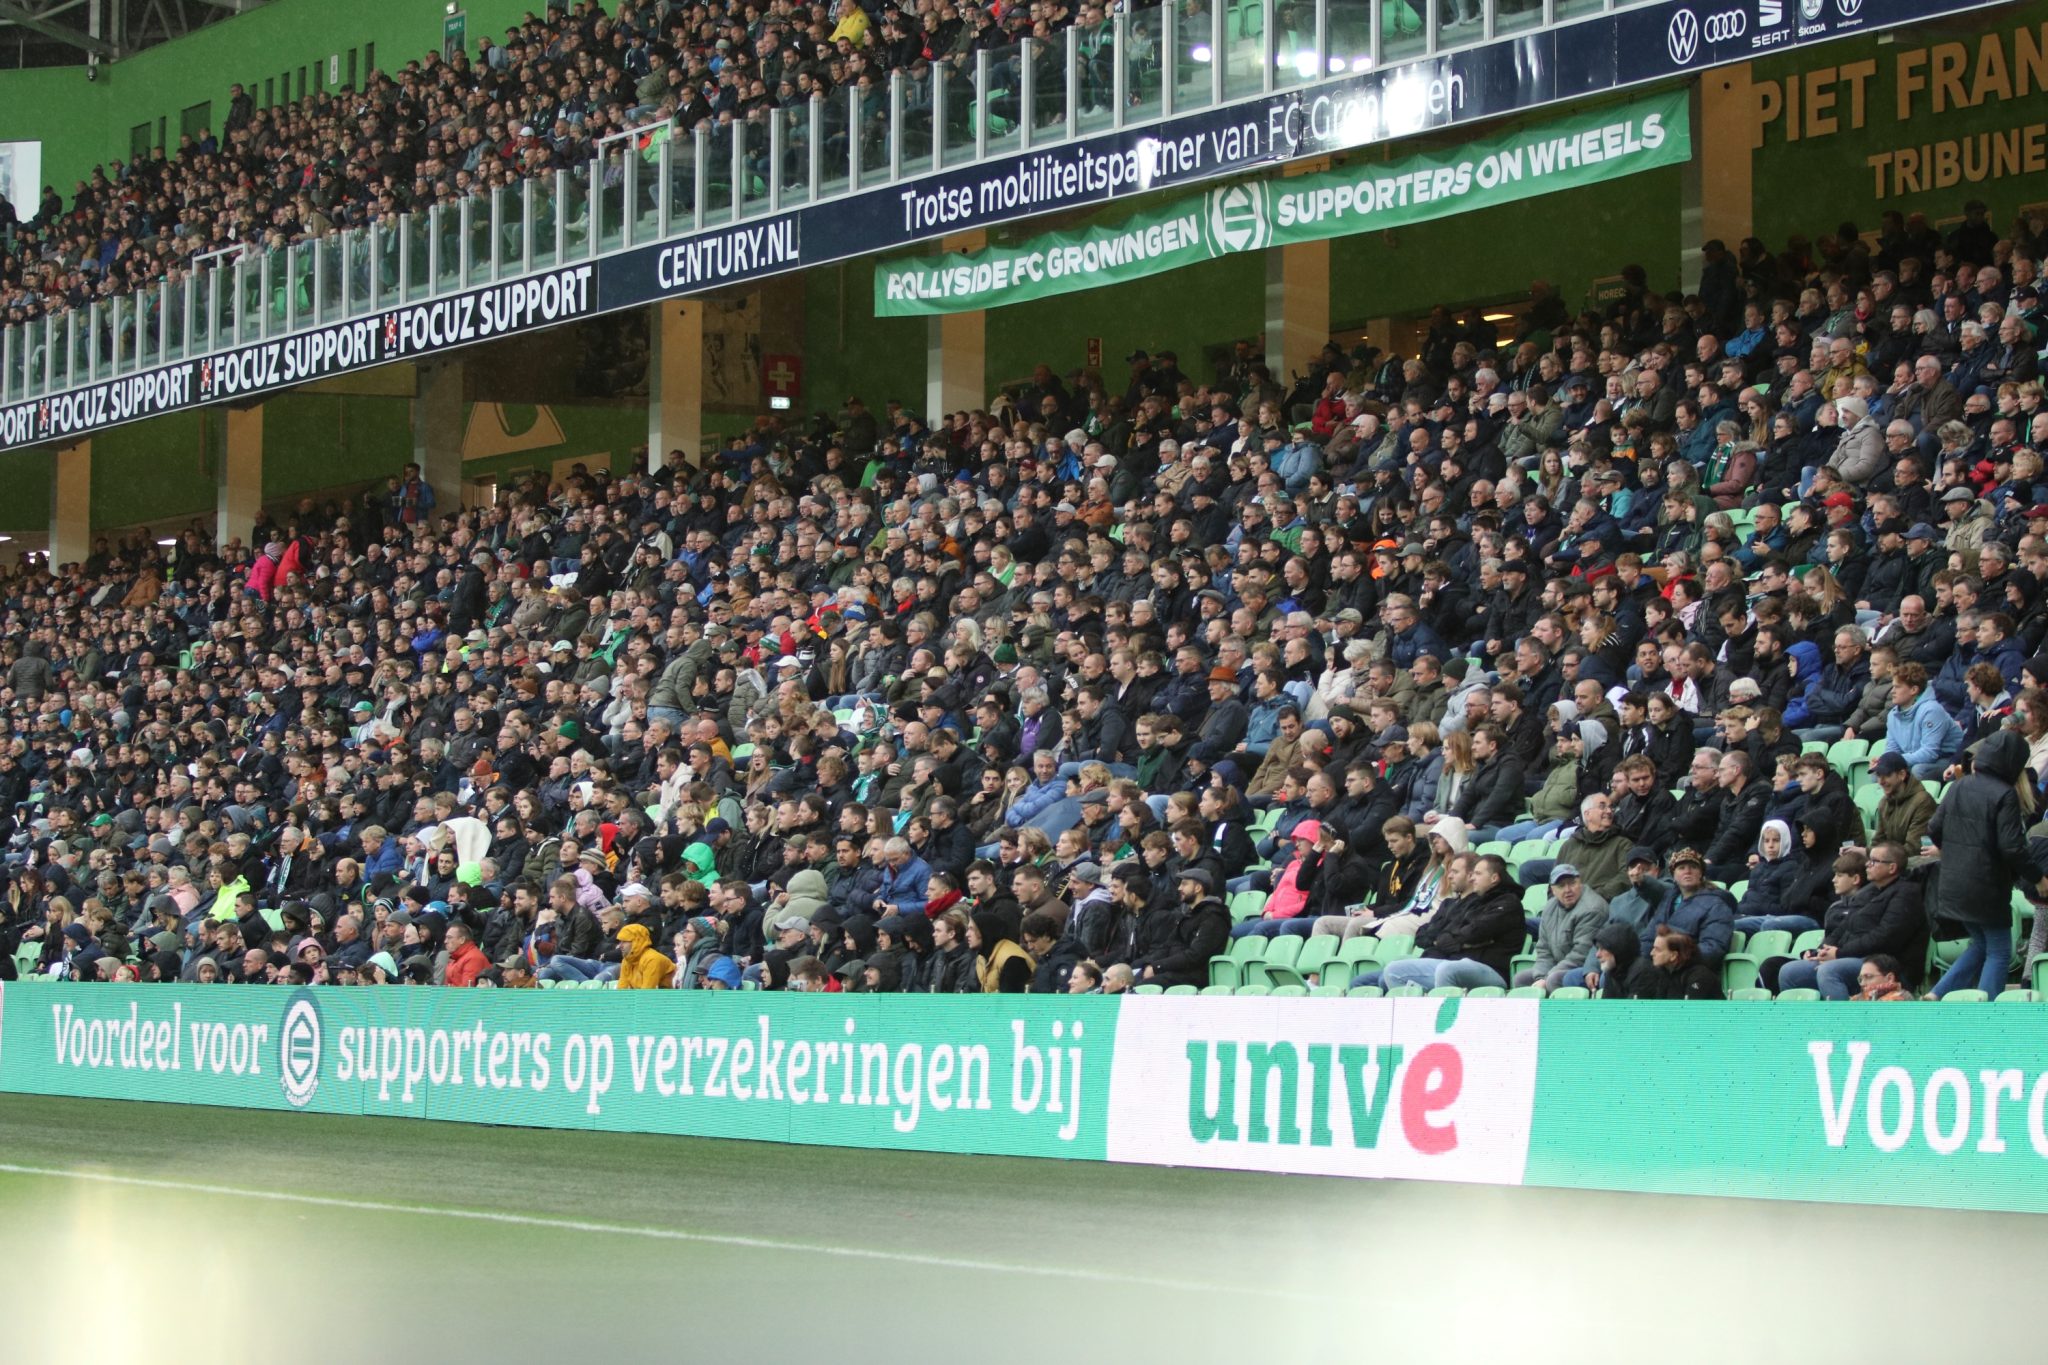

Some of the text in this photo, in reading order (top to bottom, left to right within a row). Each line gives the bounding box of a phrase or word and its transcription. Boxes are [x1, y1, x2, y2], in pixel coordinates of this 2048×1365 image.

[1752, 29, 1790, 48] SEAT
[1751, 59, 1876, 149] PIET
[901, 185, 972, 231] Trotse
[980, 133, 1206, 214] mobiliteitspatner
[1212, 121, 1259, 164] van
[1269, 104, 1302, 153] FC
[1278, 113, 1665, 227] SUPPORTERS ON WHEELS
[1868, 123, 2046, 199] TRIBUNE
[658, 219, 798, 290] CENTURY.NL
[887, 214, 1199, 300] ROLLYSIDE FC GRONINGEN
[401, 266, 592, 353] FOCUZ SUPPORT
[51, 363, 193, 435] FOCUZ SUPPORT
[214, 318, 380, 397] FOCUZ SUPPORT
[52, 1002, 181, 1071] Voordeel
[191, 1023, 267, 1075] voor
[338, 1020, 551, 1102] supporters
[563, 1032, 614, 1115] op
[628, 1015, 991, 1133] verzekeringen
[1011, 1020, 1083, 1141] bij
